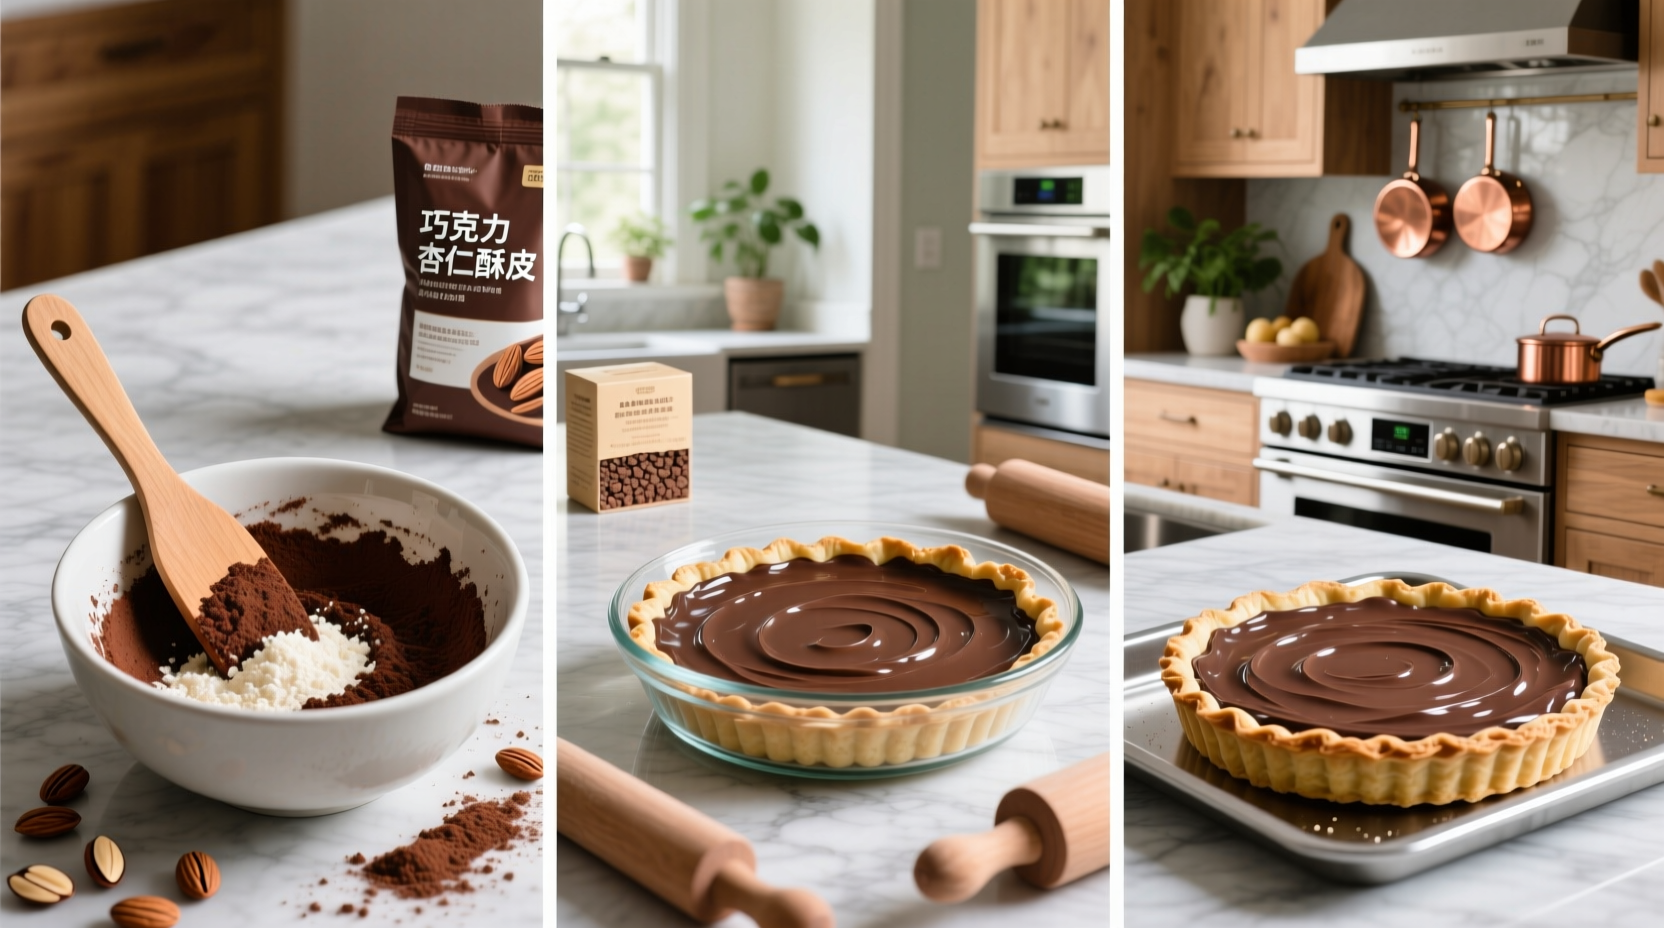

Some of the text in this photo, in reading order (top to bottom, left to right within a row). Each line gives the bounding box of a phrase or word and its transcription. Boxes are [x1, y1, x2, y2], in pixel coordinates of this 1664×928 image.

[419, 210, 510, 244] 巧克力
[418, 242, 537, 282] 杏仁酥皮
